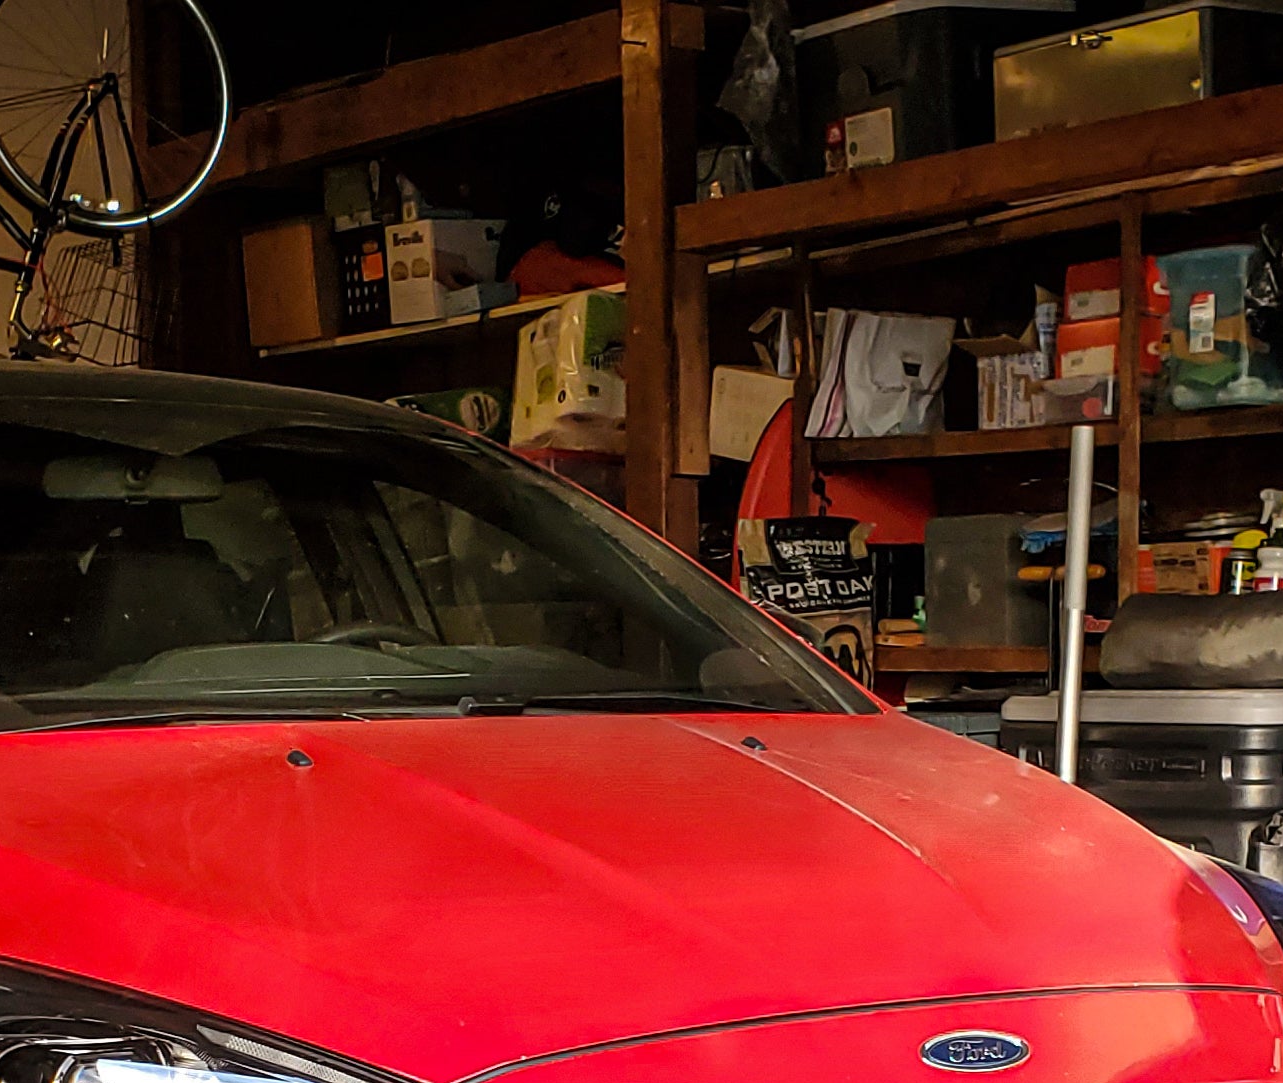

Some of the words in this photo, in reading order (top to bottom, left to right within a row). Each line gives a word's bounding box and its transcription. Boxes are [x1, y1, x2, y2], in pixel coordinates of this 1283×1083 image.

[767, 579, 833, 601] POST
[836, 575, 874, 596] OAK
[948, 1040, 1007, 1063] Ford
